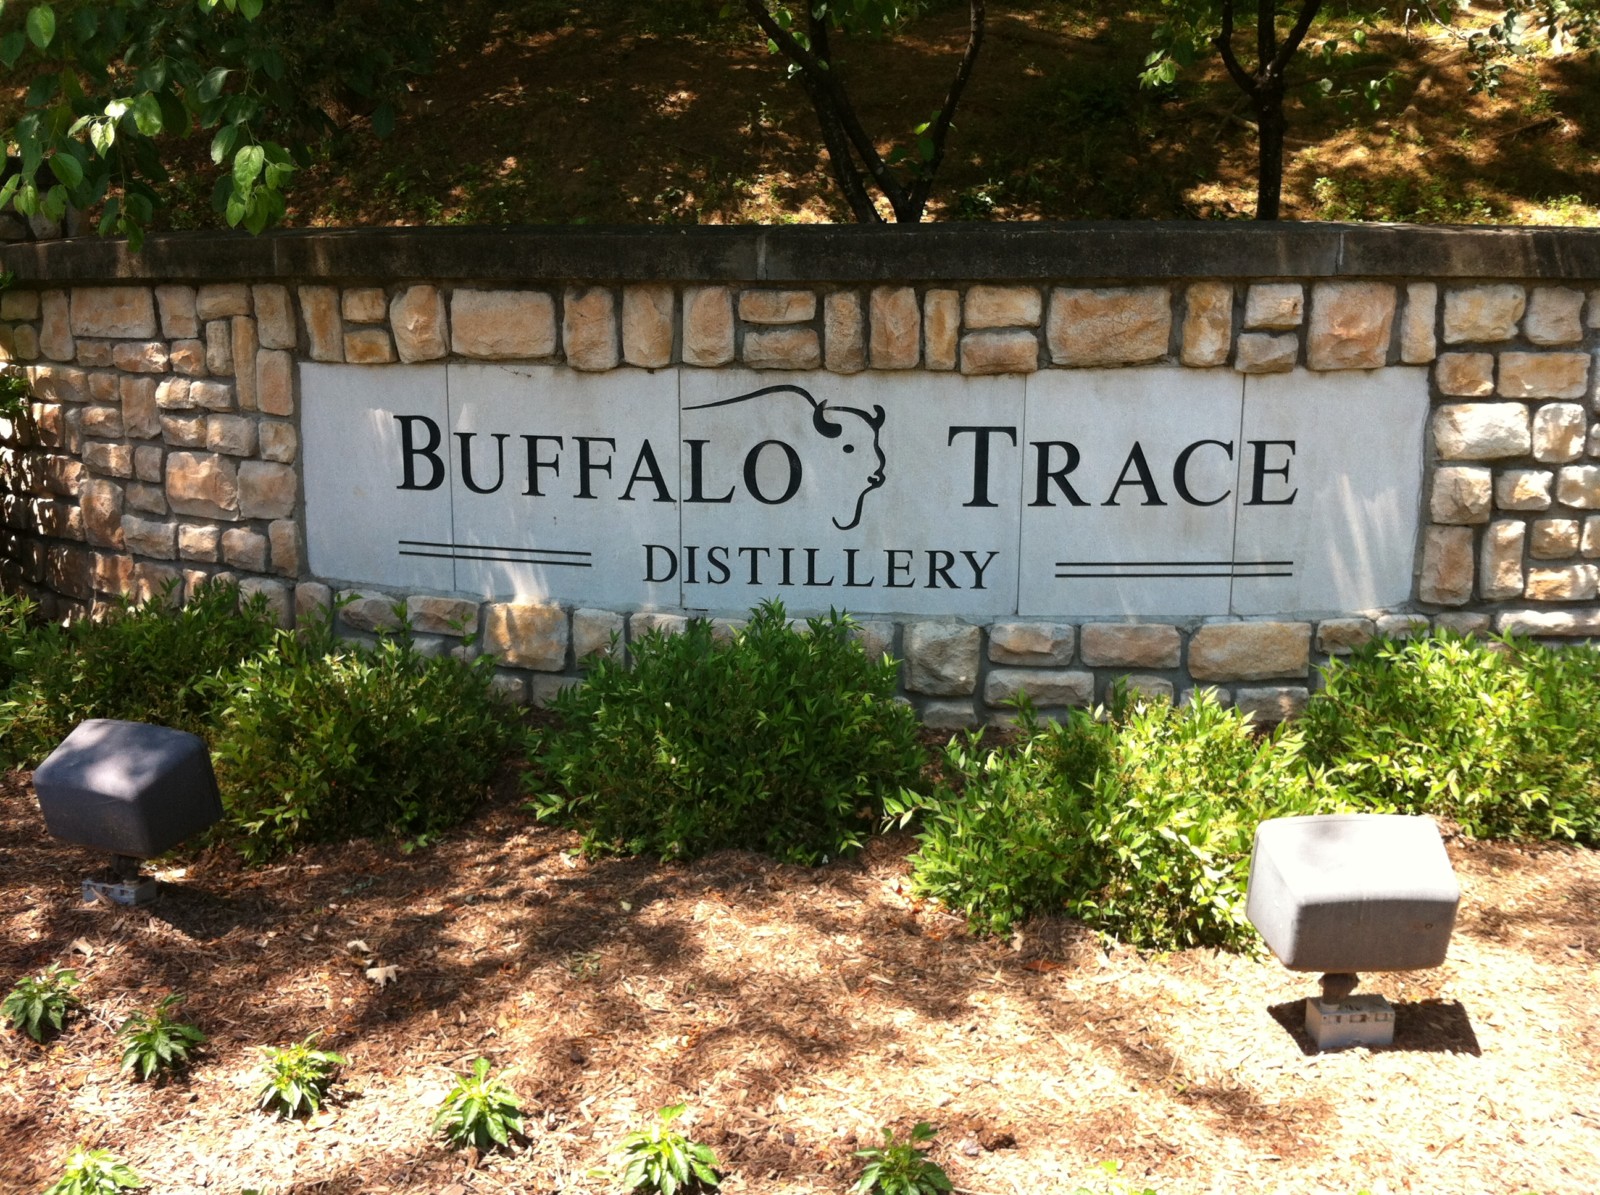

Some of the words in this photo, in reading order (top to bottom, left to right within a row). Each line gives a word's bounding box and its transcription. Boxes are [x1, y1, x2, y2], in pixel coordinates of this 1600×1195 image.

[392, 413, 804, 506] BUFFALO
[946, 424, 1300, 509] TRACE
[641, 543, 1001, 590] DISTILLERY
